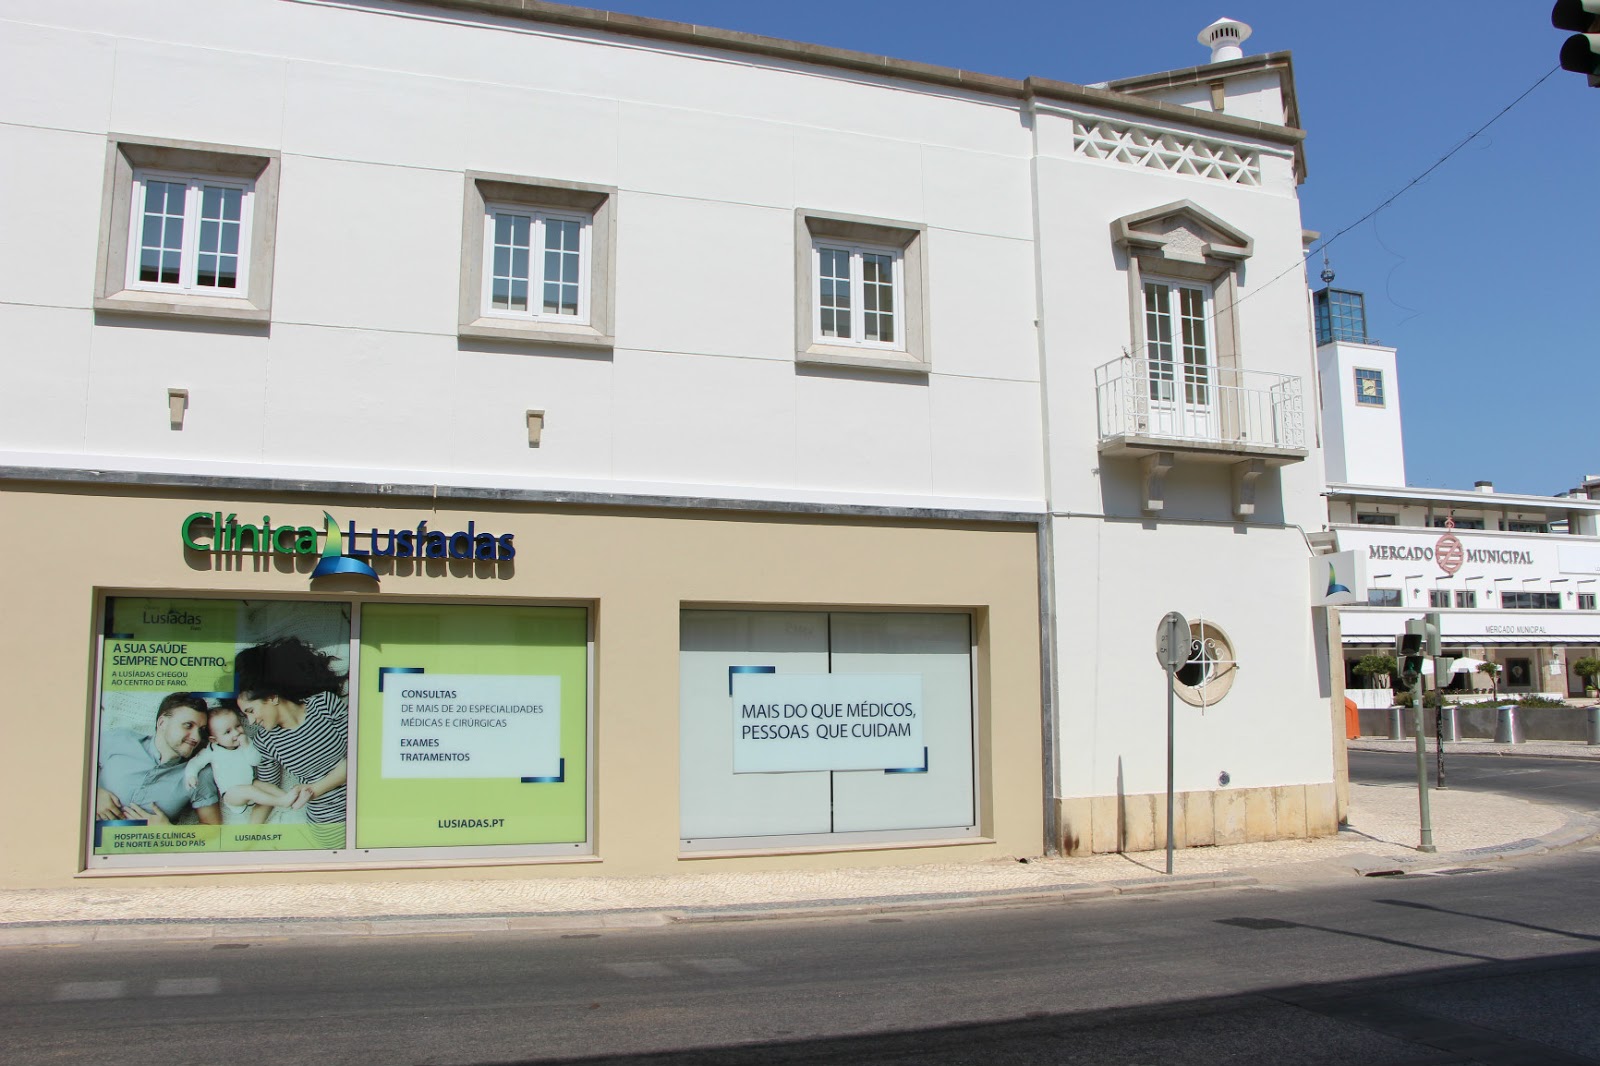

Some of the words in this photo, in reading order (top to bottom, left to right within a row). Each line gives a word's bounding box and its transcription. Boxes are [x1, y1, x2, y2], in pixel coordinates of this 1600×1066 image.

[181, 511, 318, 554] Clínica
[348, 519, 516, 562] Lusíadas
[1369, 545, 1434, 560] MERCADO
[1466, 549, 1534, 565] MUNICIPAL
[1485, 625, 1515, 634] MERCADO
[1516, 625, 1547, 634] MUNICIPAL
[113, 643, 121, 653] A
[123, 643, 147, 653] SUA
[149, 641, 187, 654] SAÚDE
[112, 655, 158, 666] SEMPRE
[160, 656, 178, 666] NO
[179, 656, 227, 667] CENTRO.
[112, 670, 117, 678] A
[118, 670, 155, 678] LUSÍADAS
[156, 670, 188, 678] CHEGOU
[401, 689, 457, 699] CONSULTAS
[401, 704, 414, 713] DE
[415, 704, 440, 713] MAIS
[441, 704, 454, 713] DE
[456, 704, 468, 713] 20
[469, 704, 544, 714] ESPECIALIDADES
[742, 703, 780, 719] MAIS
[784, 703, 808, 718] DO
[811, 703, 843, 719] QUE
[846, 701, 916, 718] MÉDICOS,
[400, 717, 444, 727] MÉDICAS
[445, 718, 450, 727] E
[452, 717, 508, 728] CIRÚRGICAS
[742, 724, 810, 740] PESSOAS
[816, 723, 849, 740] QUE
[851, 722, 911, 738] CUIDAM
[400, 738, 440, 747] EXAMES
[400, 752, 471, 762] TRATAMENTOS
[438, 818, 505, 828] LUSIADAS.PT
[234, 834, 283, 842] LUSIADAS.PT
